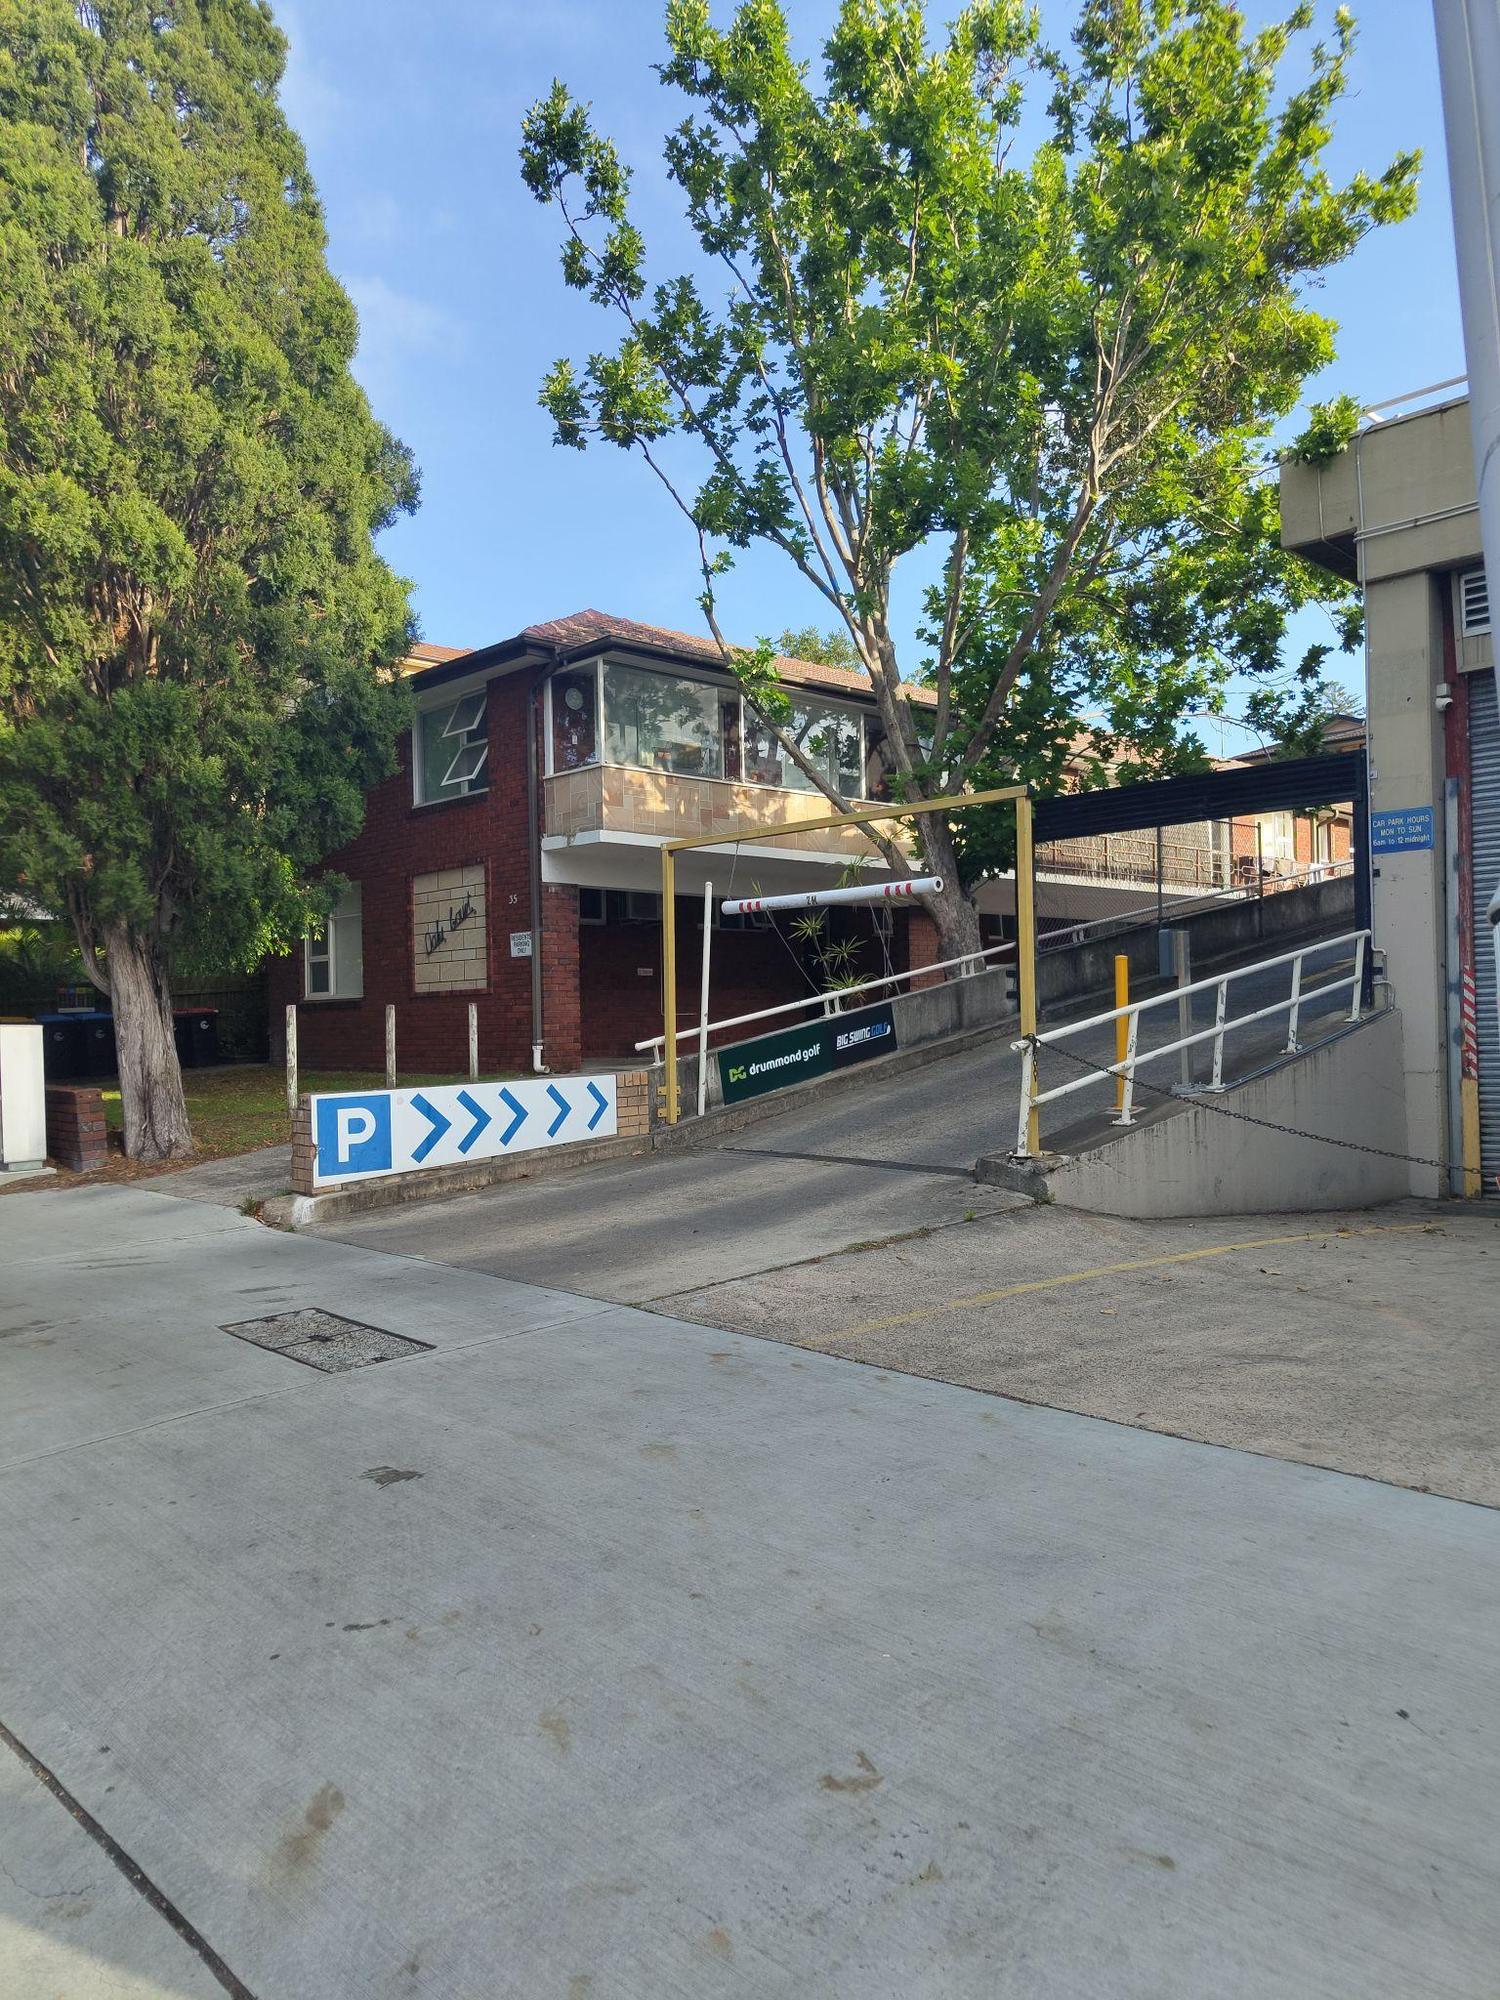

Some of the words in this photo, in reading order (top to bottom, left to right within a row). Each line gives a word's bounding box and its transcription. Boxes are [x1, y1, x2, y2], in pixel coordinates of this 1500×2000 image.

[1372, 820, 1386, 828] CAR
[1387, 817, 1404, 826] PARK
[1406, 814, 1430, 824] HOURS
[1380, 828, 1395, 837] MON
[1397, 826, 1406, 835] TO
[1408, 824, 1422, 834] SUN
[836, 1033, 849, 1047] BIG
[848, 1026, 871, 1043] SWING
[871, 1022, 888, 1037] GOLF
[748, 1049, 802, 1075] drummond
[802, 1043, 821, 1062] golf
[337, 1107, 376, 1163] P
